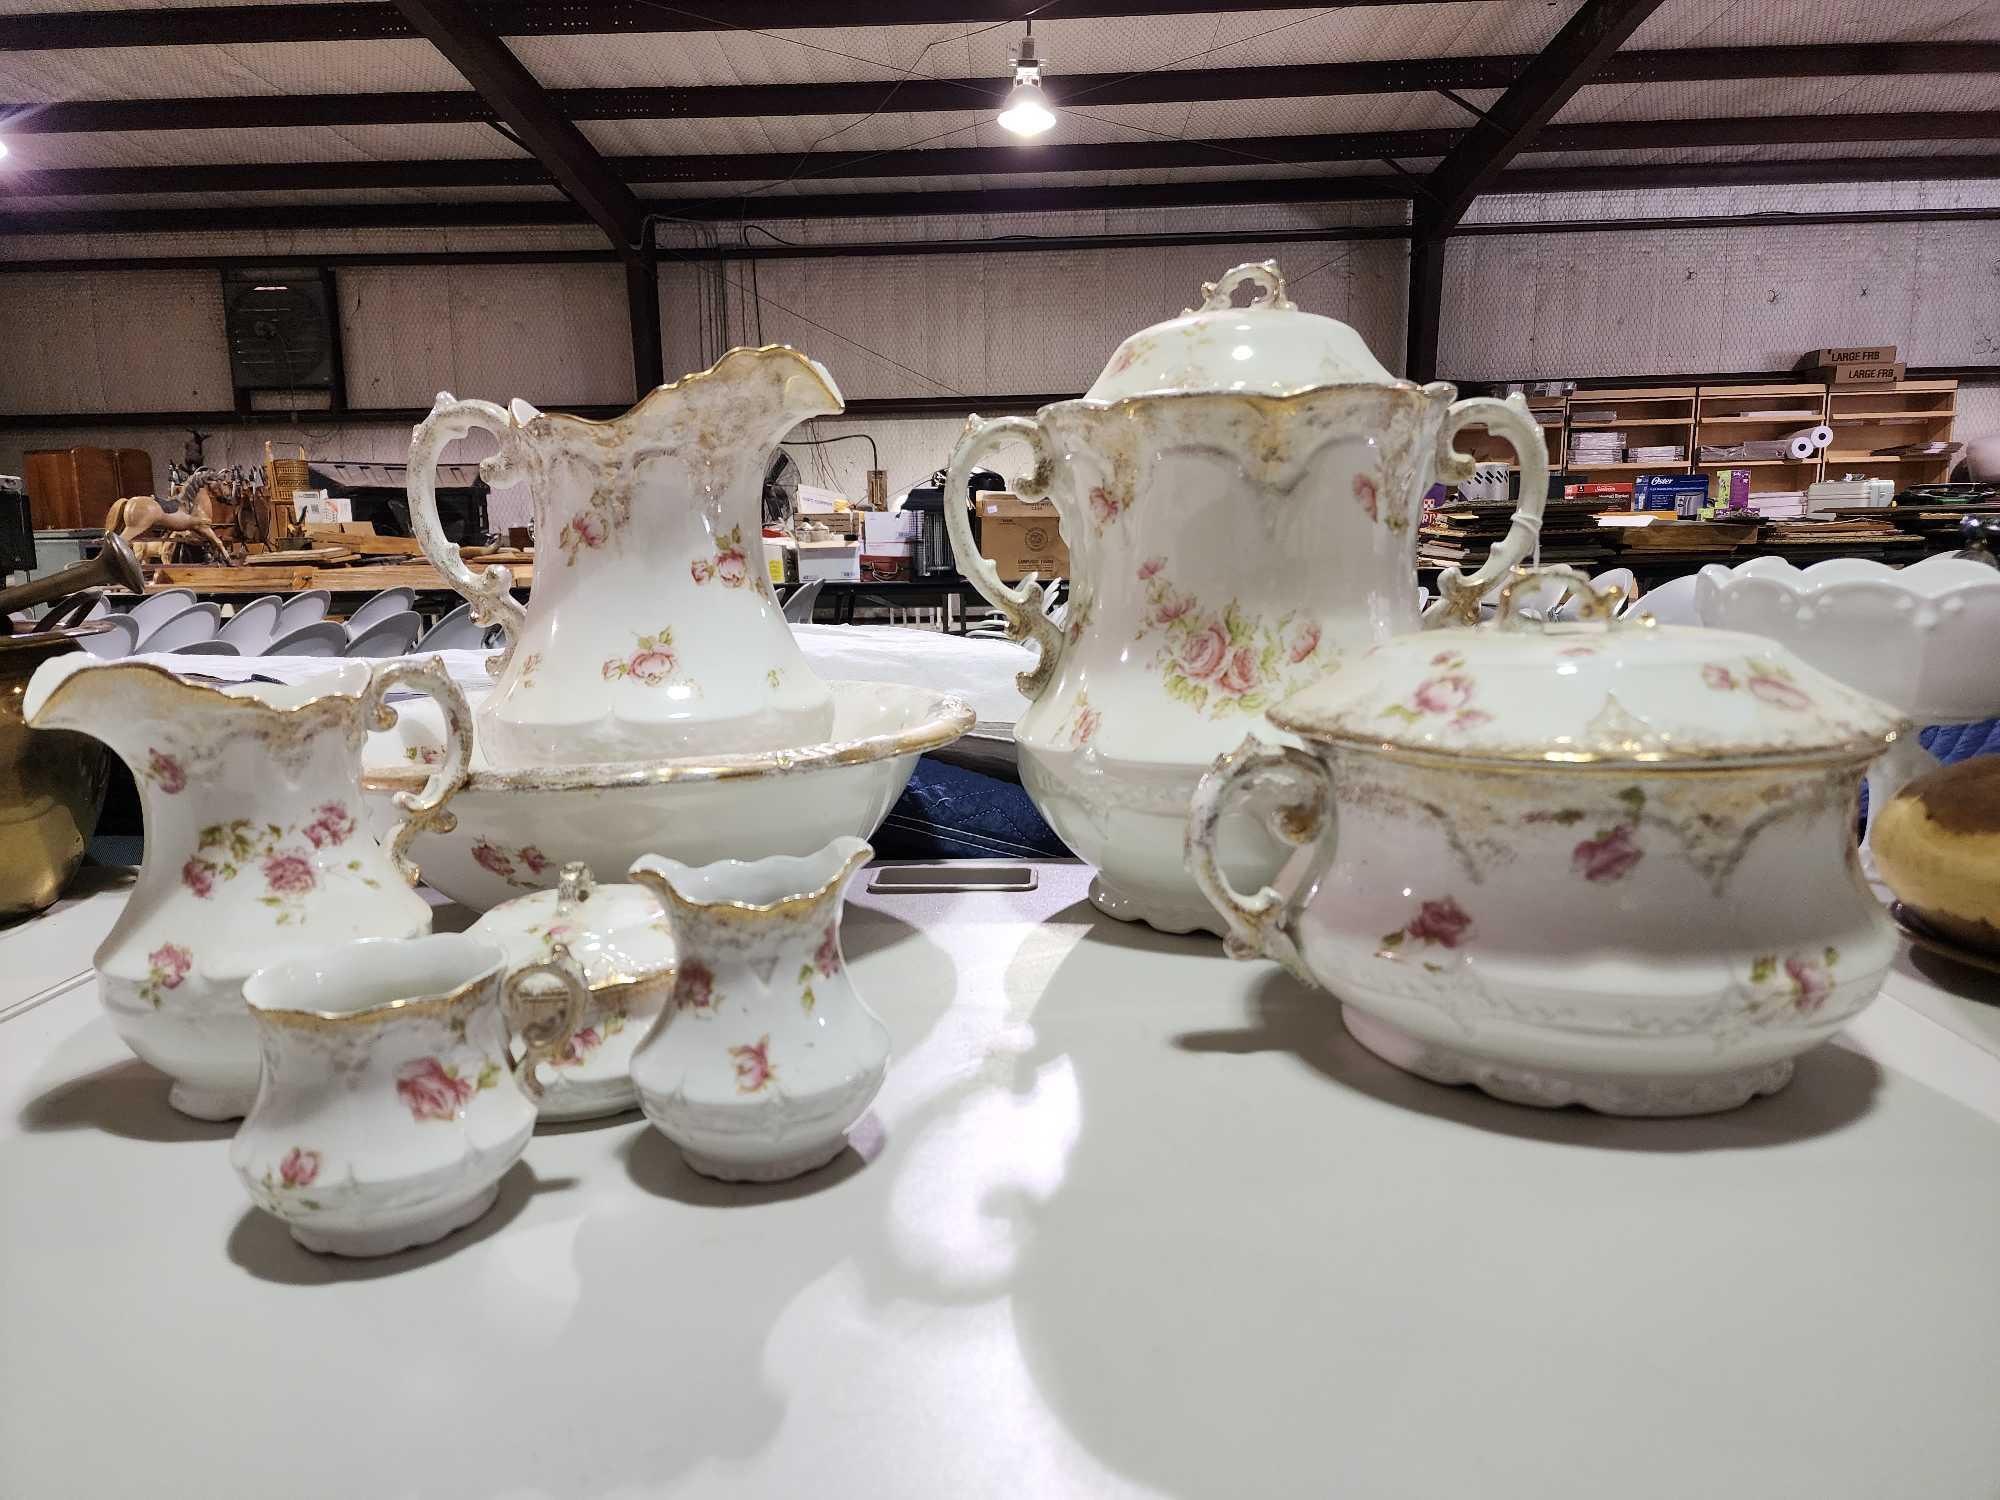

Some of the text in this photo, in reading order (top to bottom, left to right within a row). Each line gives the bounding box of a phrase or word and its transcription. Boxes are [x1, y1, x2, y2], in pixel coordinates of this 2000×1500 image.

[1832, 351, 1880, 361] LARGE FRB
[1849, 368, 1894, 378] LARGE FRB
[1651, 477, 1674, 486] Oster
